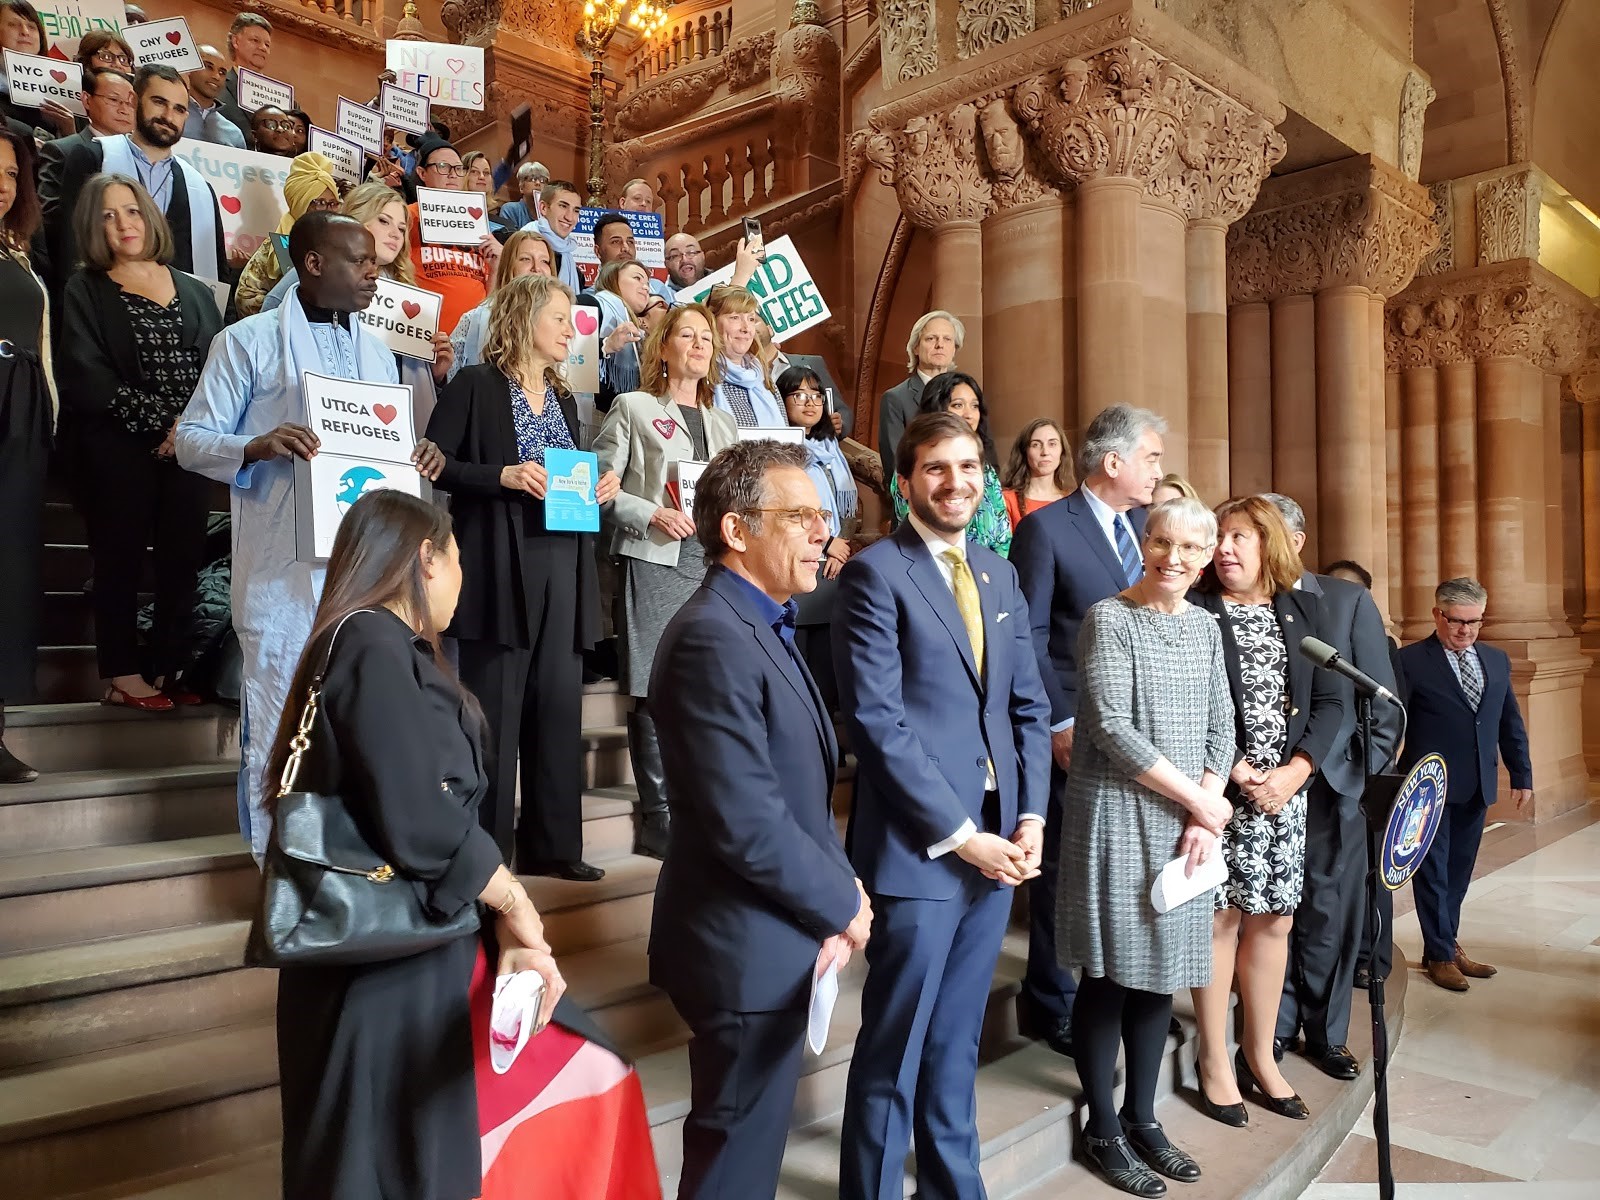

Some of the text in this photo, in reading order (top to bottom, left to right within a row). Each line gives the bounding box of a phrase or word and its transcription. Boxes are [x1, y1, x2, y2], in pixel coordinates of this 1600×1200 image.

[140, 36, 161, 48] CNY
[138, 47, 189, 64] REFUGEES
[400, 47, 432, 70] NY
[13, 63, 43, 77] NYC
[12, 79, 81, 101] REFUGEES
[392, 95, 419, 108] SUPPORT
[347, 110, 373, 125] SUPPORT
[385, 110, 427, 128] RESETTLEMENT
[392, 104, 418, 117] REFUGEE
[347, 119, 372, 134] REFUGEE
[340, 126, 381, 146] RESETTLEMENT
[322, 140, 353, 157] SUPPORT
[322, 150, 352, 166] REFUGEE
[422, 203, 467, 214] BUFFALO
[424, 218, 475, 229] REFUGEES
[422, 263, 456, 272] PEOPLE
[358, 311, 433, 342] REFUGEES
[321, 396, 371, 417] UTICA
[321, 418, 401, 442] REFUGEES
[1398, 761, 1444, 809] NEW YORK STATE
[1386, 864, 1412, 884] SENATE
